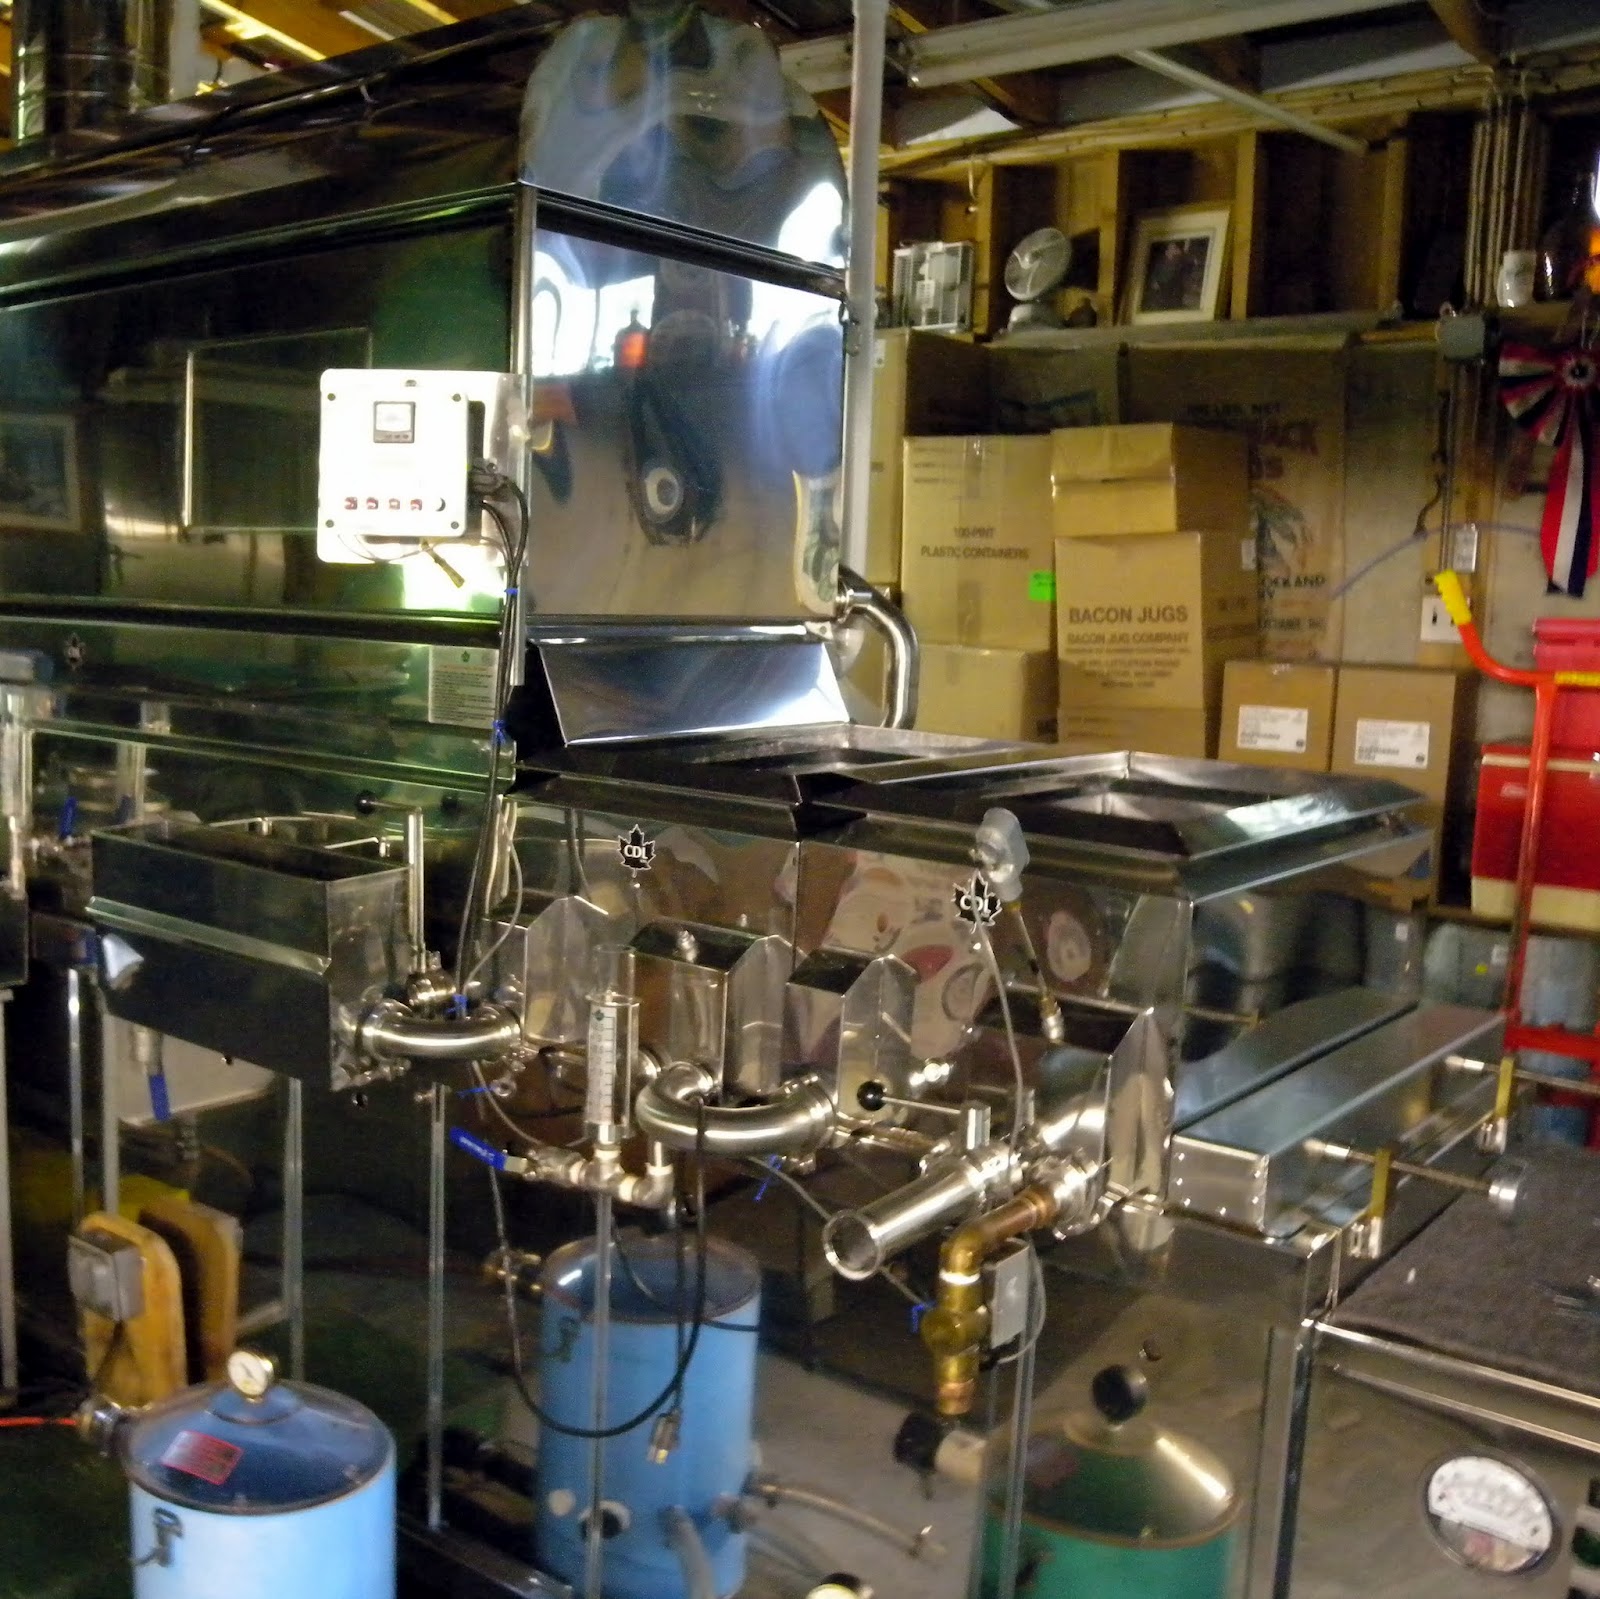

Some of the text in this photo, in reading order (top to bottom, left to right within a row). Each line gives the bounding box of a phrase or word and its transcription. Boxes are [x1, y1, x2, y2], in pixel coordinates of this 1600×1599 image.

[920, 545, 1030, 560] PLASTIC CONTAINERS
[1069, 605, 1188, 624] BACON JUGS
[1067, 632, 1189, 644] BACON JUG COMPANY
[624, 844, 649, 860] CDL
